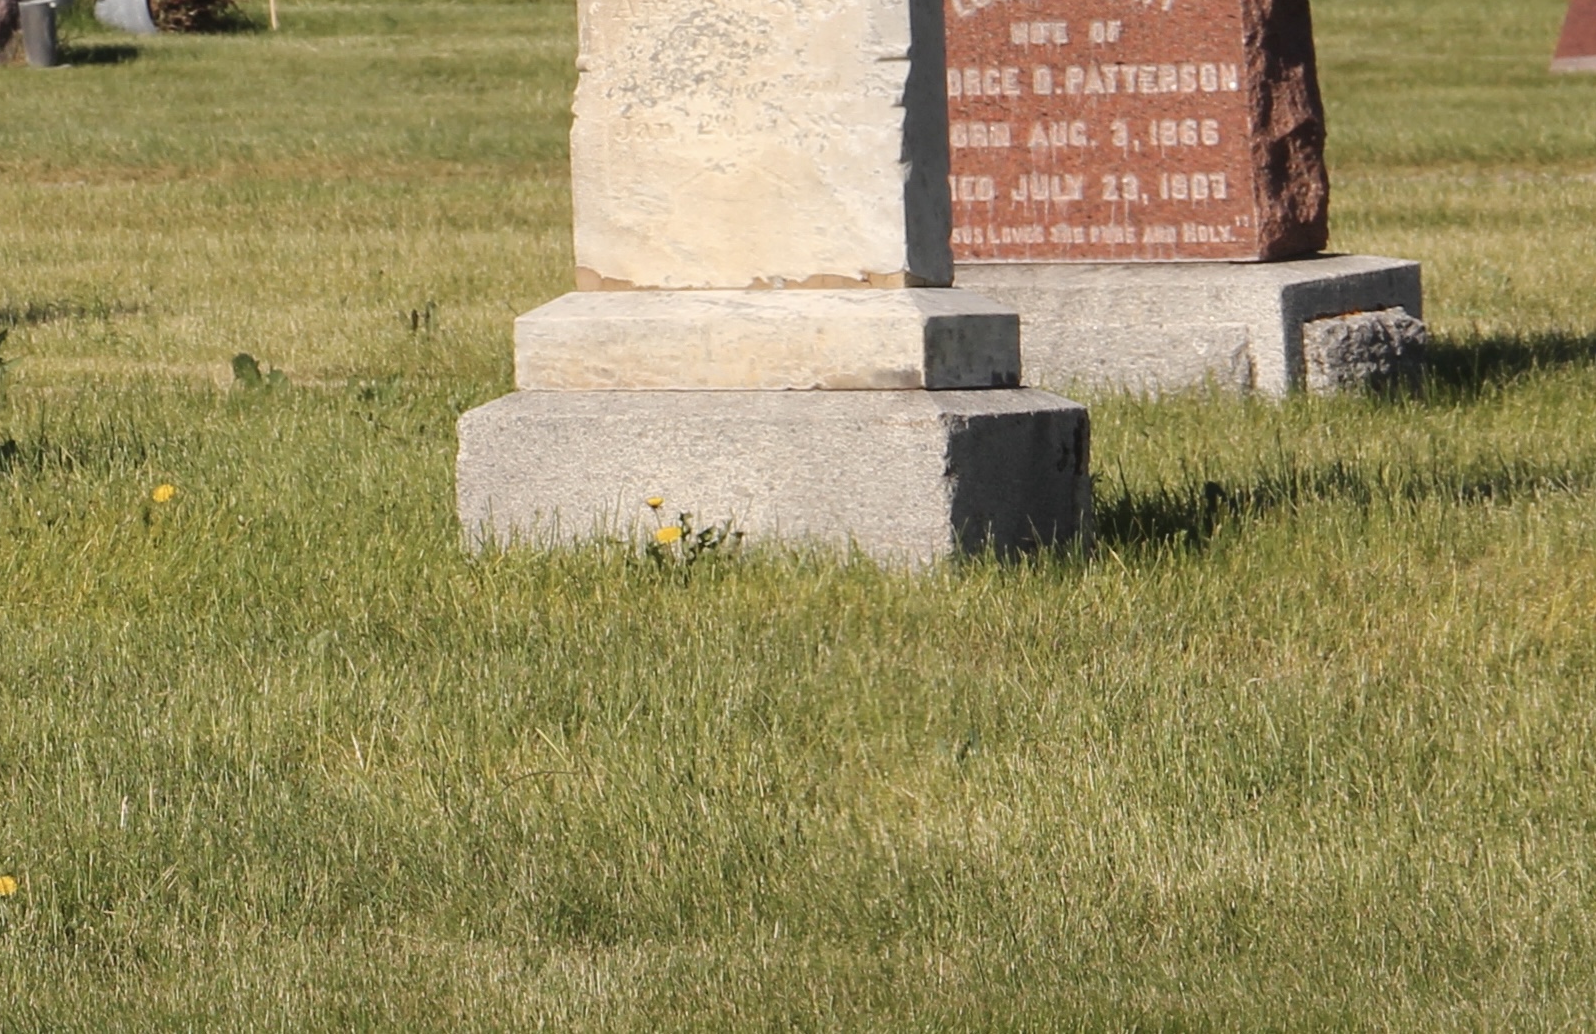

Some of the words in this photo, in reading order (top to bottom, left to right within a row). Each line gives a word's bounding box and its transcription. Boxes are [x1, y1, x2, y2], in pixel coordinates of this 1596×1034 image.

[1010, 20, 1070, 46] WIFE
[1088, 20, 1123, 44] OF
[947, 66, 1022, 97] ORGE
[948, 120, 1011, 148] ORN
[1026, 118, 1099, 148] AUG.
[1149, 117, 1220, 147] 1866
[948, 173, 996, 202] IED
[1011, 172, 1084, 202] JULY
[952, 225, 985, 245] SUS
